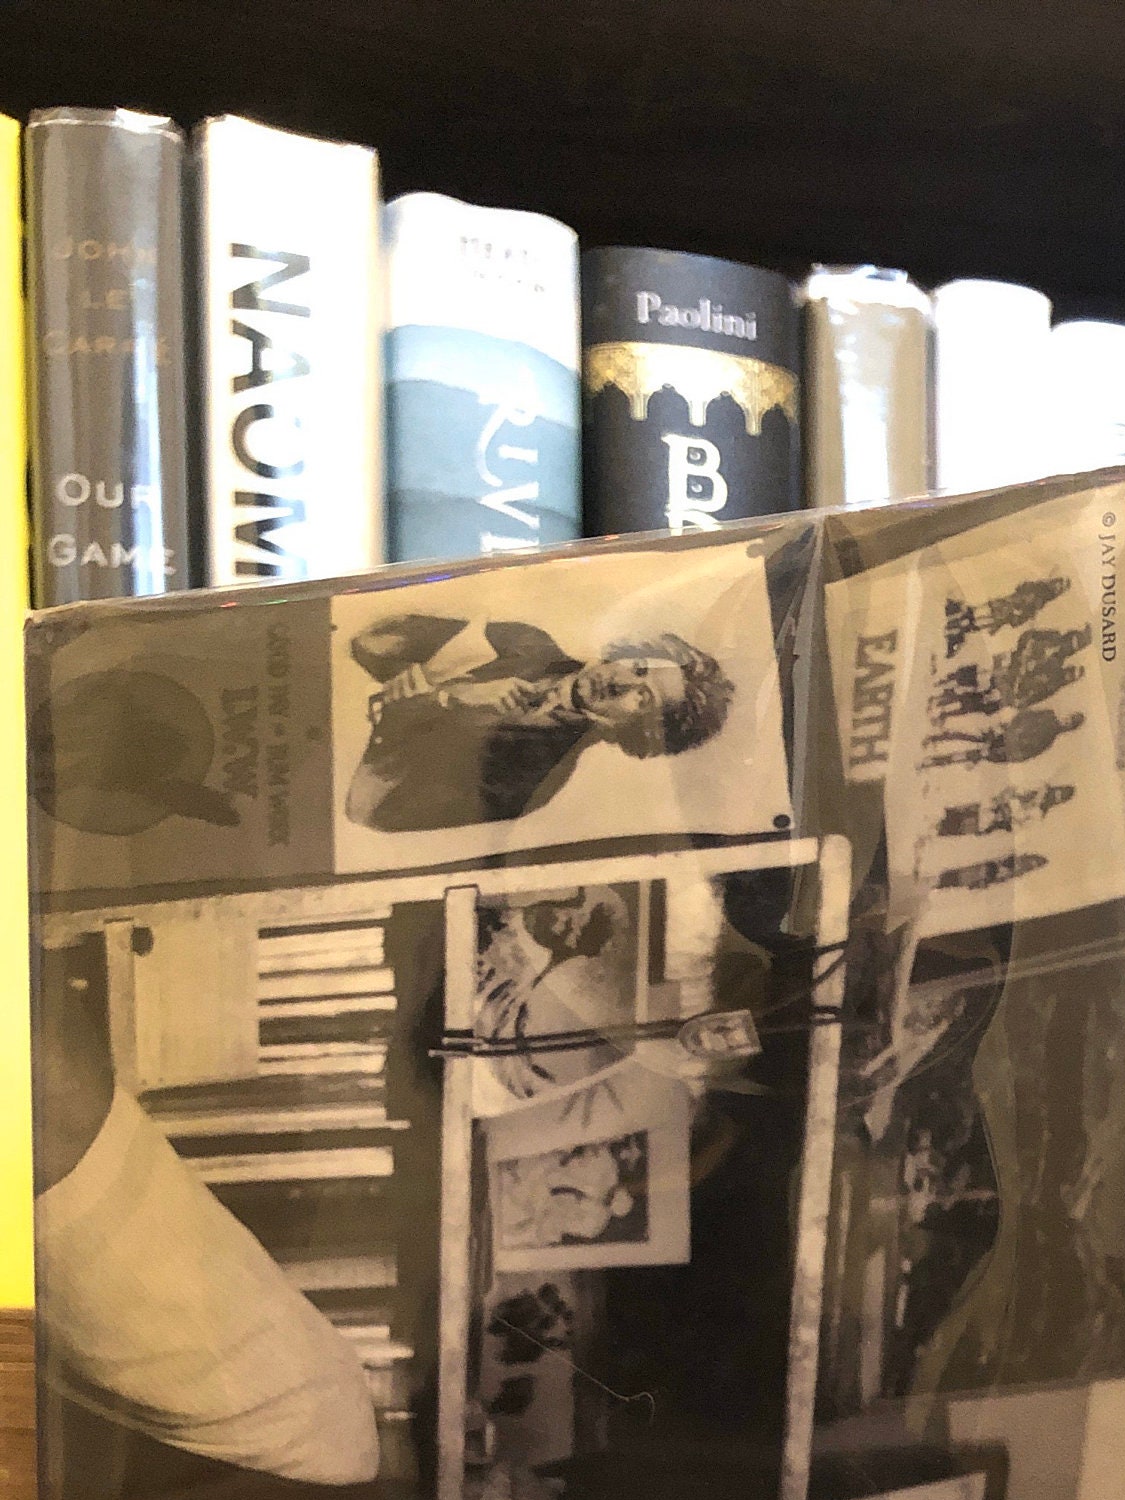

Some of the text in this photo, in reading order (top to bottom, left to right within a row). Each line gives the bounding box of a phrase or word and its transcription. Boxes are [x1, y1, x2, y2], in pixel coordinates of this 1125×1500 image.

[635, 290, 758, 341] Paolini
[1099, 534, 1116, 568] JAY
[1101, 573, 1117, 663] DUSARD
[850, 628, 899, 767] EARTH
